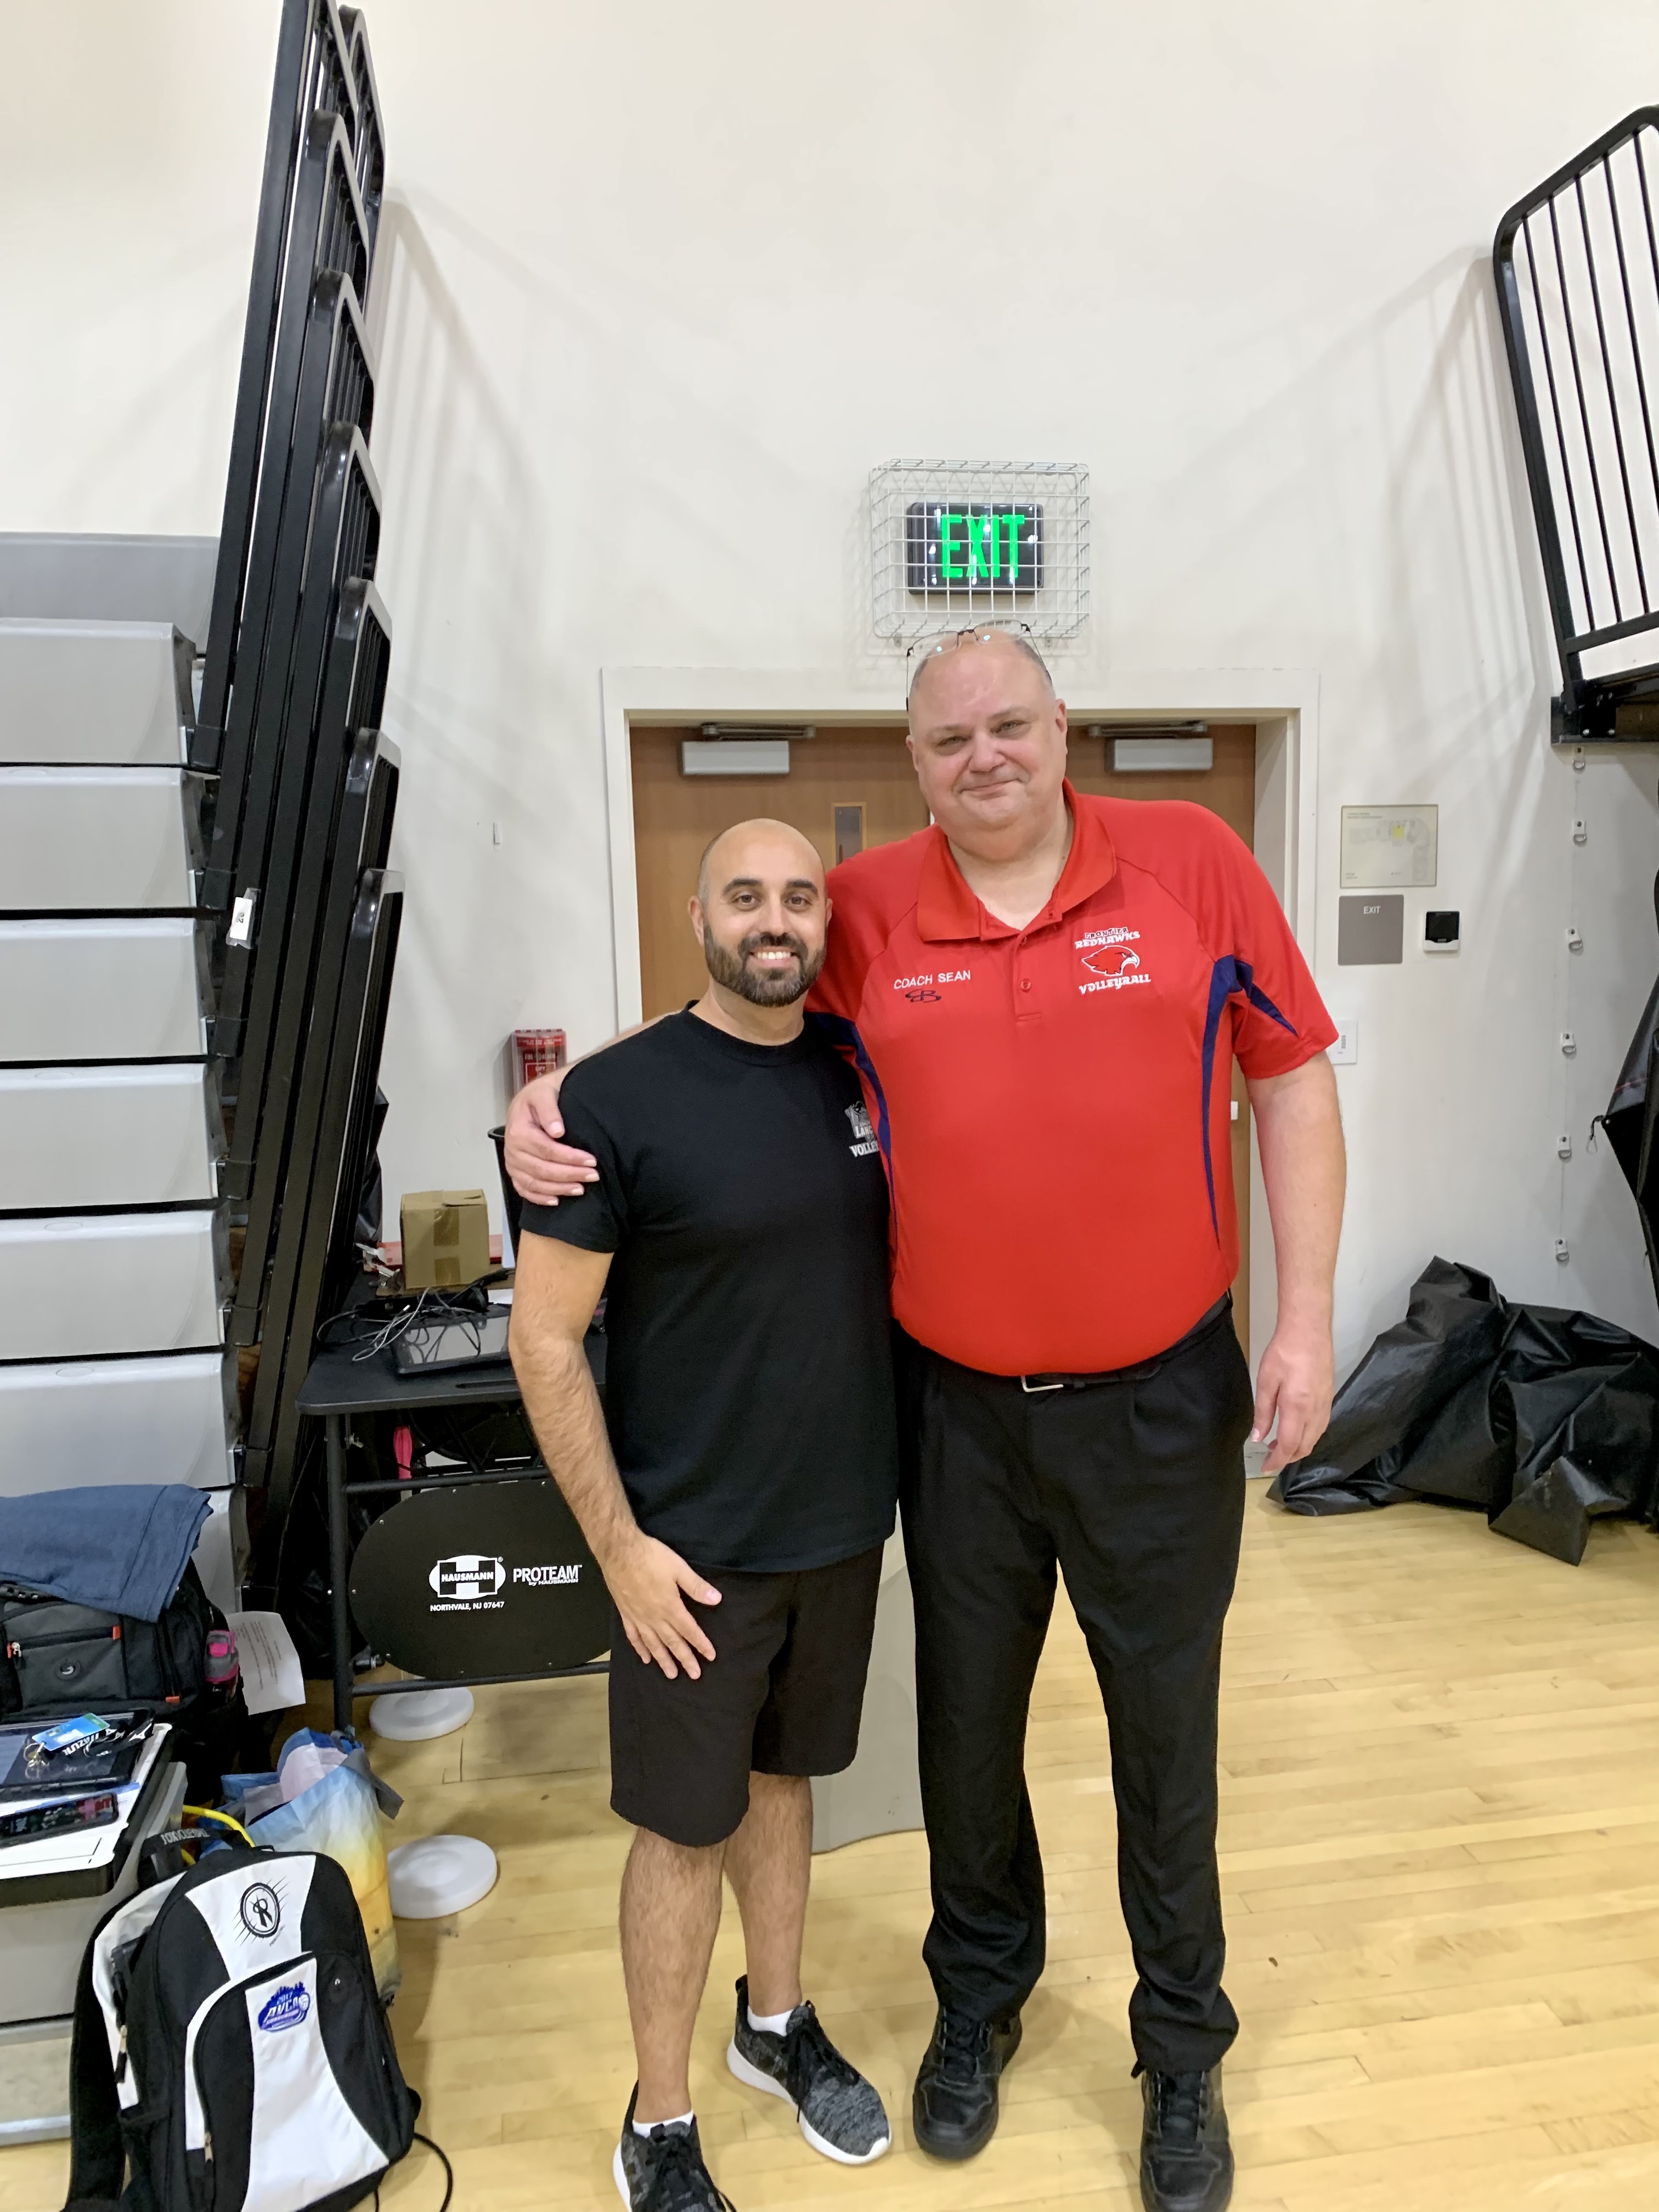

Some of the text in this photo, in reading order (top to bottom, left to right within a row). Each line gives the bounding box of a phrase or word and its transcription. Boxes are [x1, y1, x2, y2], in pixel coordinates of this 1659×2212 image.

[941, 514, 1025, 578] EXIT
[1363, 906, 1381, 915] EXIT
[1075, 931, 1141, 949] REDHAWKS
[1085, 927, 1128, 939] FRONTIER
[893, 970, 971, 989] COACH SEAN
[1079, 974, 1152, 995] VOLLEYBALL
[441, 1571, 494, 1582] HAUSMANN
[430, 1602, 472, 1612] NORTHVALE,
[483, 1601, 505, 1609] 07647
